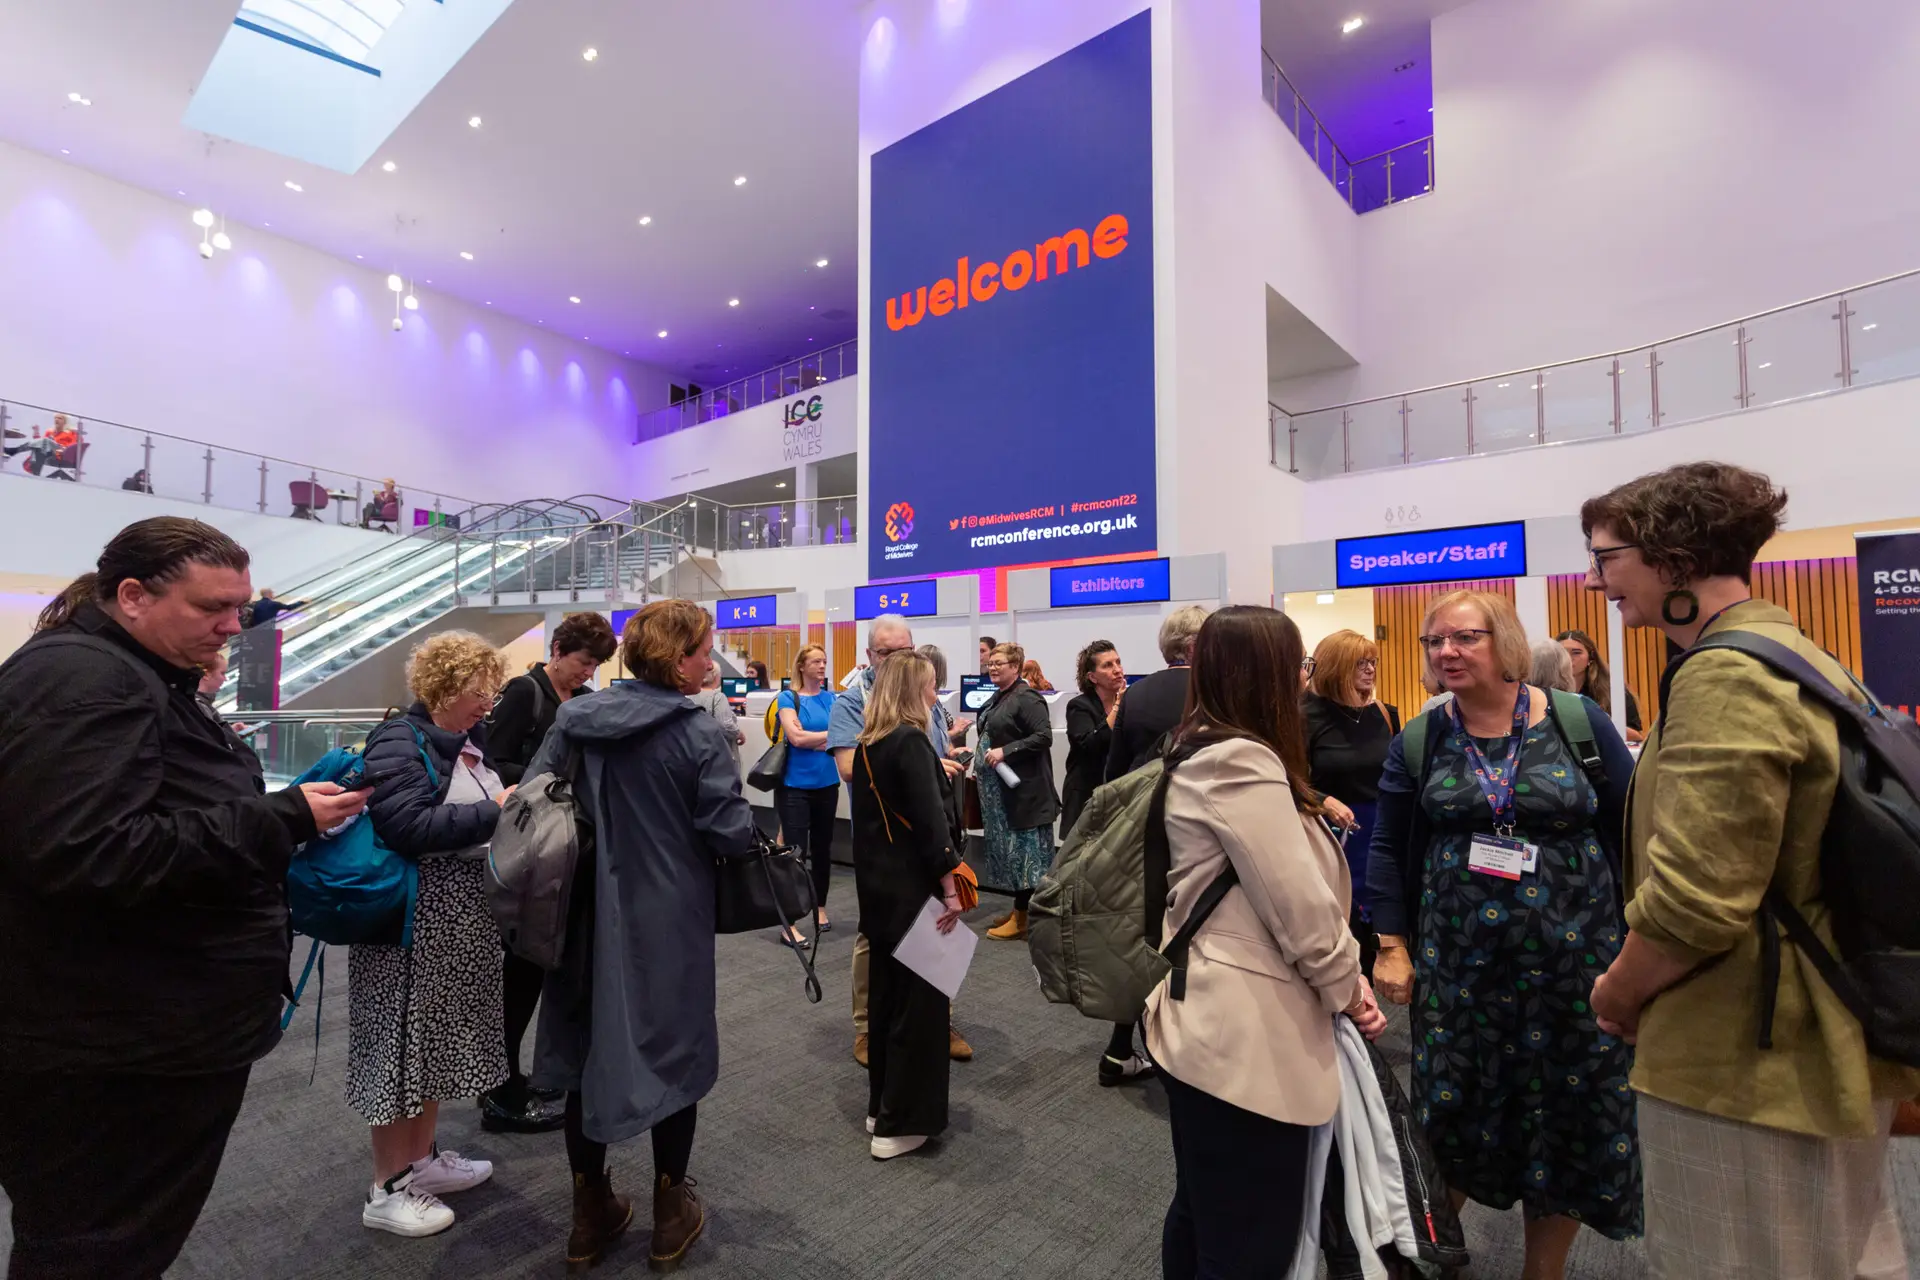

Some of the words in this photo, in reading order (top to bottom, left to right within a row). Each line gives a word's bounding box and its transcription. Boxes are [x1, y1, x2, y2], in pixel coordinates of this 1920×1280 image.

[886, 214, 1129, 331] welcome
[785, 395, 822, 429] ICC
[783, 423, 822, 446] CYMRU
[783, 439, 822, 461] WALES
[979, 506, 1054, 527] @MidwivesRCM
[1071, 494, 1137, 513] #rcmconf22
[971, 514, 1137, 548] rcmconference.org.uk
[885, 545, 899, 553] Royal
[1350, 541, 1508, 572] Speaker/Staff
[1072, 577, 1144, 593] Exhibitors
[879, 594, 888, 608] S
[900, 593, 909, 607] Z
[734, 608, 740, 619] K
[750, 606, 756, 618] R
